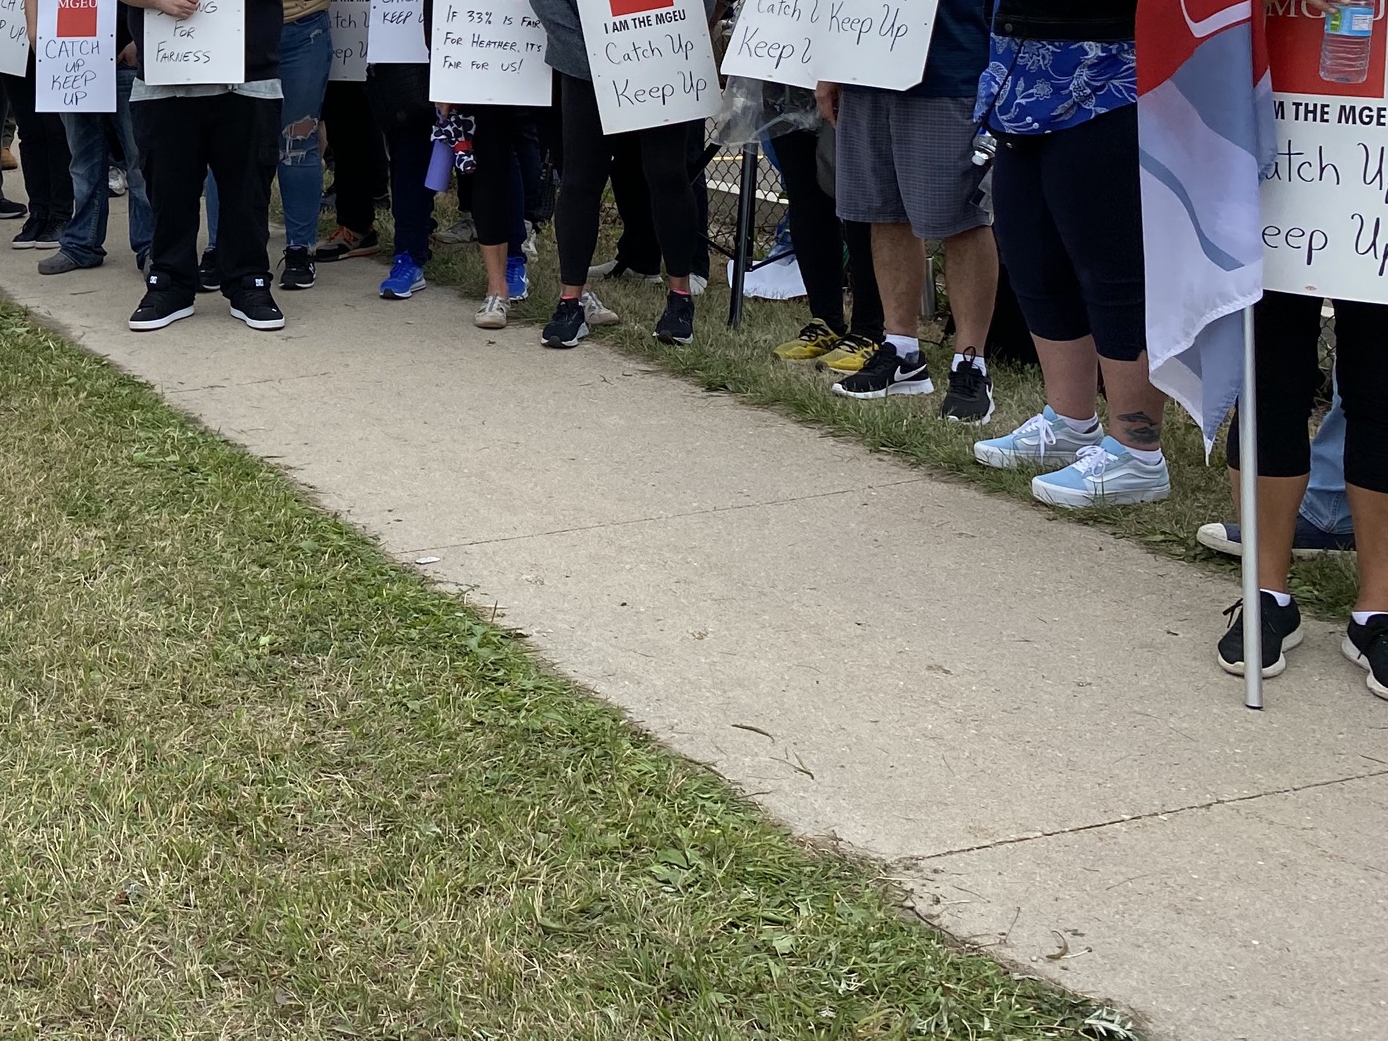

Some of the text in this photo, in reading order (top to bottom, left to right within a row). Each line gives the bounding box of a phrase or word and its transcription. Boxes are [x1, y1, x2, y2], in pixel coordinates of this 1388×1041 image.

[382, 11, 413, 25] KEEP
[446, 4, 541, 29] IF 33% IS FAIR
[604, 9, 686, 34] I AM THE MGEU
[828, 2, 873, 45] Keep
[878, 4, 909, 52] Up
[173, 19, 196, 39] FOR
[444, 32, 463, 46] FOR
[45, 39, 100, 59] CATCH
[605, 33, 694, 65] Catch Up
[738, 26, 795, 69] Keep
[65, 58, 85, 73] UP
[443, 56, 462, 69] FAIR
[471, 60, 489, 71] FOR
[51, 70, 97, 91] KEEP
[612, 70, 707, 107] Keep Up
[63, 91, 88, 106] UP
[1292, 102, 1330, 123] THE
[1337, 105, 1387, 126] MGE
[1266, 139, 1340, 185] tch
[1262, 225, 1329, 266] eep
